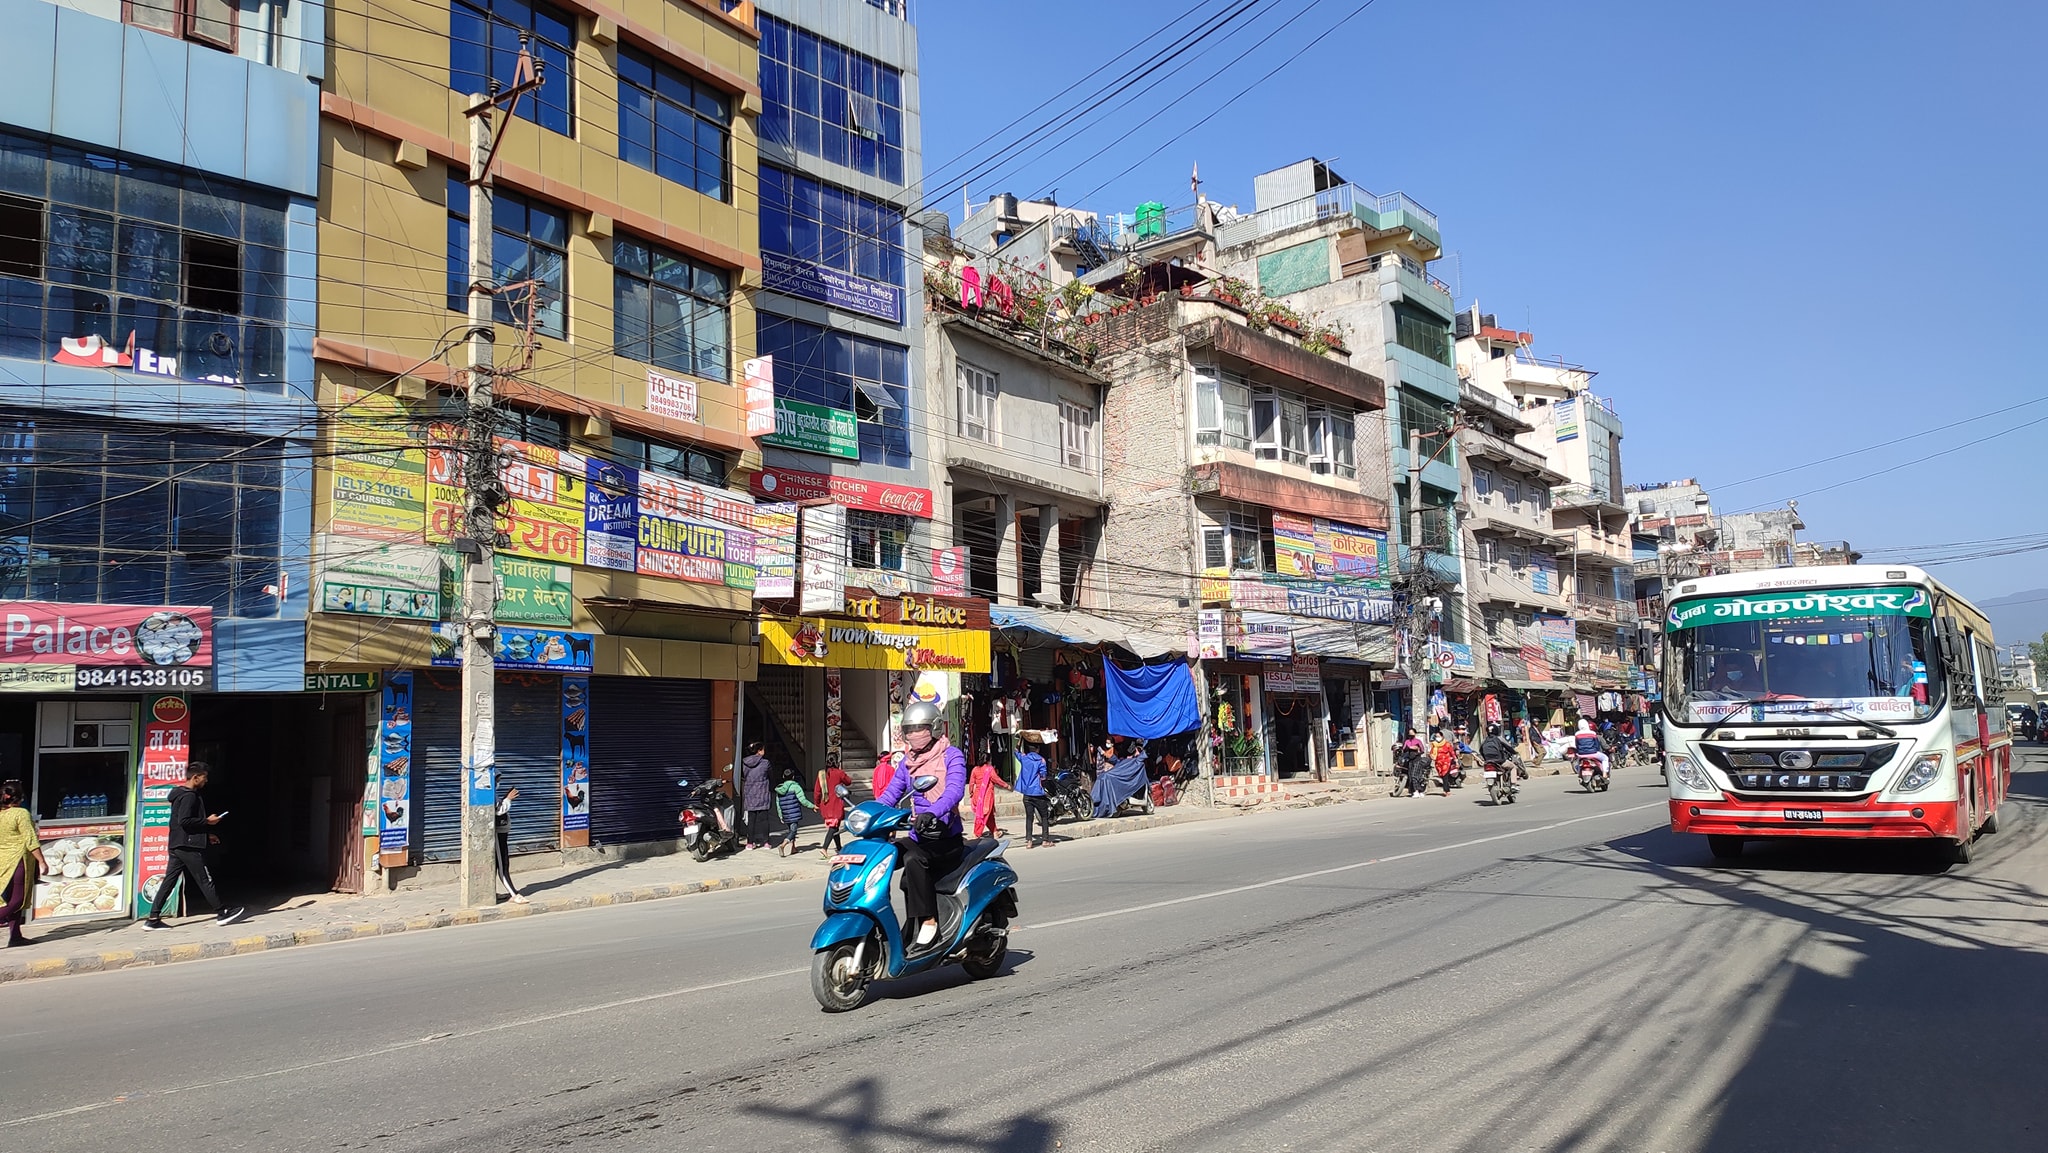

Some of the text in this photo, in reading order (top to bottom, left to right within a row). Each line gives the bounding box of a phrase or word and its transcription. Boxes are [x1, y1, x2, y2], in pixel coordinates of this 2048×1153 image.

[802, 281, 832, 297] GENERAL
[833, 290, 867, 306] INSURANCE
[650, 376, 692, 401] TO-LET
[527, 445, 557, 467] 100%
[338, 476, 414, 499] IELTS TOEFL
[779, 473, 868, 493] CHINESE KITCHEN
[336, 490, 396, 506] IT COURSES:
[785, 486, 863, 505] BURGER HOUSE
[588, 502, 632, 522] DREAM
[603, 520, 632, 531] INSTITUTE
[638, 515, 726, 560] COMPUTER
[727, 531, 752, 548] IELTS
[804, 534, 833, 546] Smart
[1333, 535, 1376, 555] कोरियन
[728, 547, 755, 563] TOEFL
[804, 549, 834, 560] Palace
[637, 550, 725, 581] CHINESE/GERMAN
[725, 562, 755, 580] TUITION
[814, 564, 823, 575] &
[803, 579, 834, 592] Events
[495, 611, 523, 619] DENTAL
[845, 596, 967, 625] art Palace
[5, 612, 131, 655] Palace
[872, 630, 919, 650] Burger
[1293, 653, 1318, 666] Carlos
[77, 669, 204, 687] 9841538105
[306, 674, 362, 689] ENTAL
[1264, 671, 1293, 682] TESLA
[1747, 775, 1852, 788] EICHER
